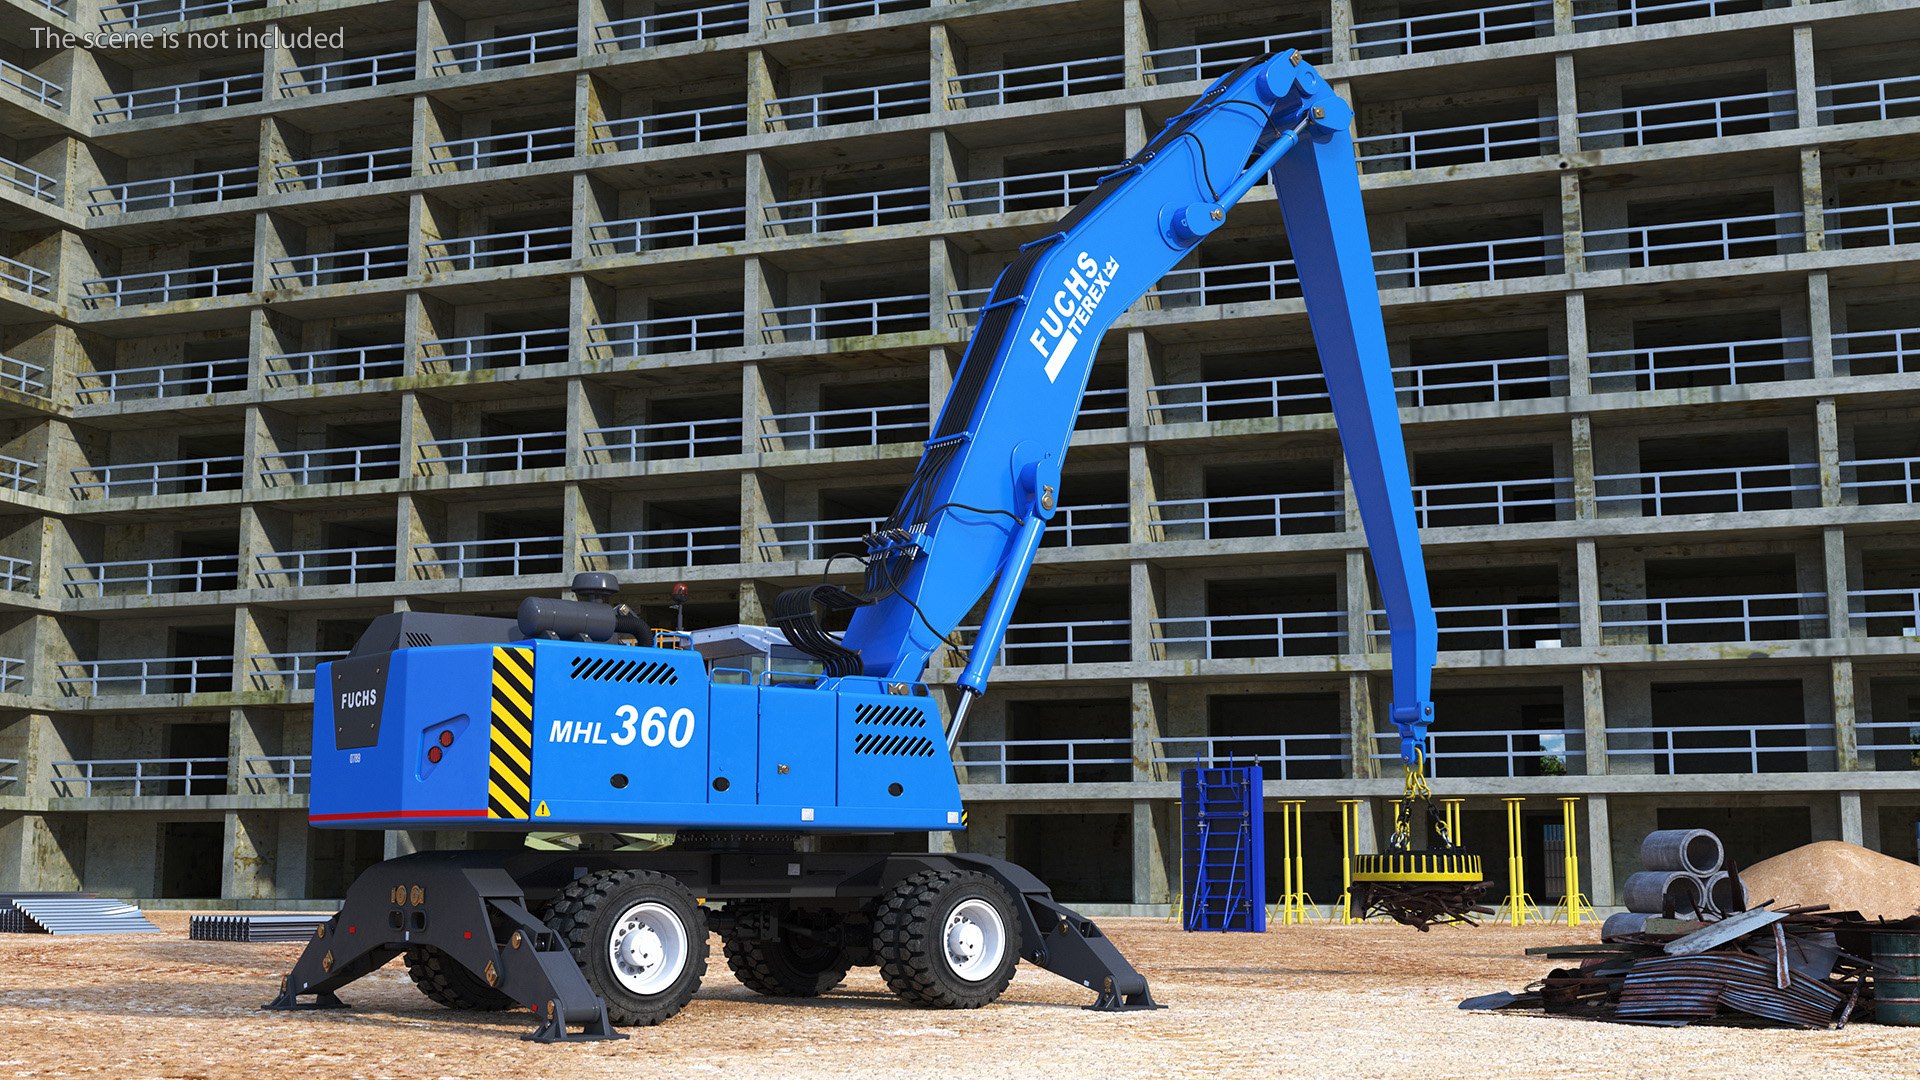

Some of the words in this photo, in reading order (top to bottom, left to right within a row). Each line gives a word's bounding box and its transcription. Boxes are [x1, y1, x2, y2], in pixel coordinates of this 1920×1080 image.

[1029, 251, 1098, 358] FUCHS
[1067, 271, 1111, 335] TEREX
[341, 688, 377, 709] FUCHS
[549, 720, 608, 745] MHL
[610, 704, 695, 749] 360
